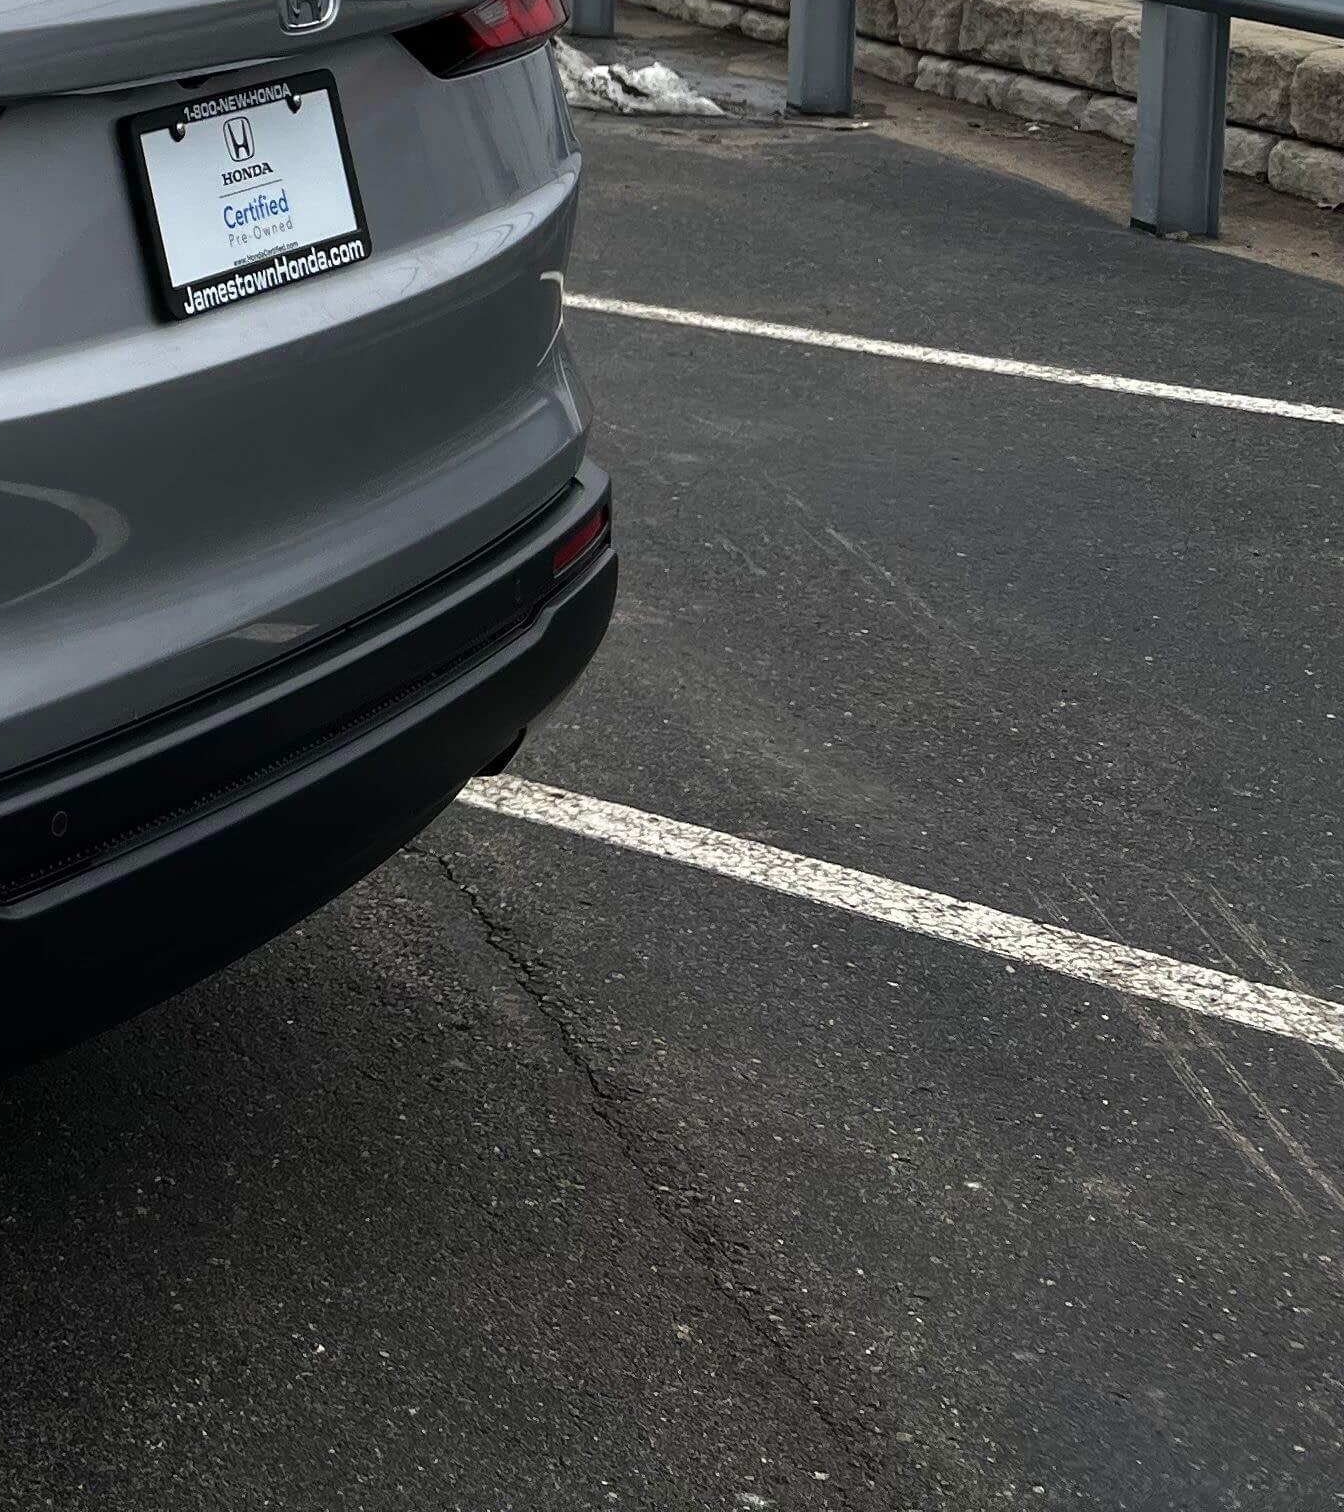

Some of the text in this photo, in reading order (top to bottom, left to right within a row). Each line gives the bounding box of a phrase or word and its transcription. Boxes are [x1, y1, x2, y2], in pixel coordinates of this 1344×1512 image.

[183, 83, 292, 122] 1-800-NEW-HONDA
[221, 162, 274, 186] HONDA
[223, 188, 289, 229] Certified
[228, 215, 293, 248] Pre-Owned
[184, 239, 365, 315] JamestownHonda.com
